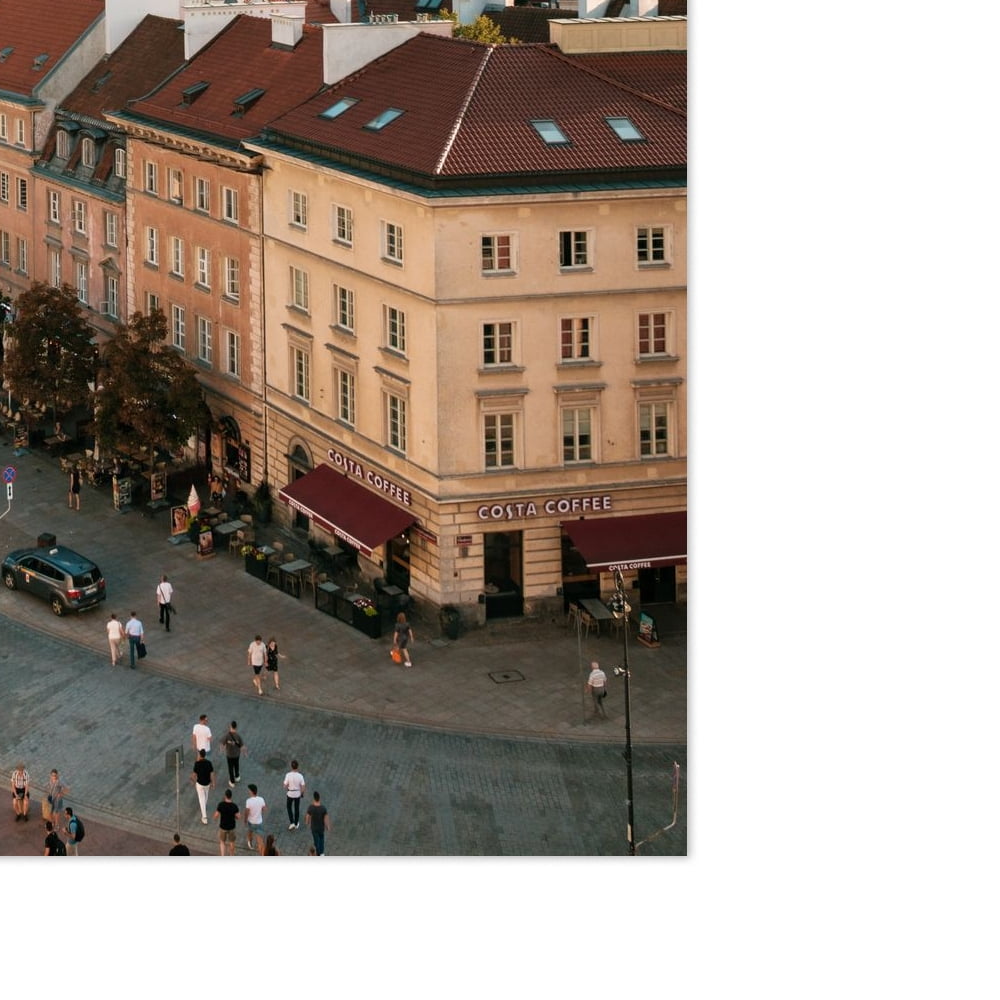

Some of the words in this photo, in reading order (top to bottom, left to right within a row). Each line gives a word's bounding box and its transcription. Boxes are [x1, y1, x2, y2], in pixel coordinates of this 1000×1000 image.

[327, 449, 363, 478] COSTA
[366, 471, 410, 506] COFFEE
[478, 503, 537, 519] COSTA
[545, 496, 611, 514] COFFEE
